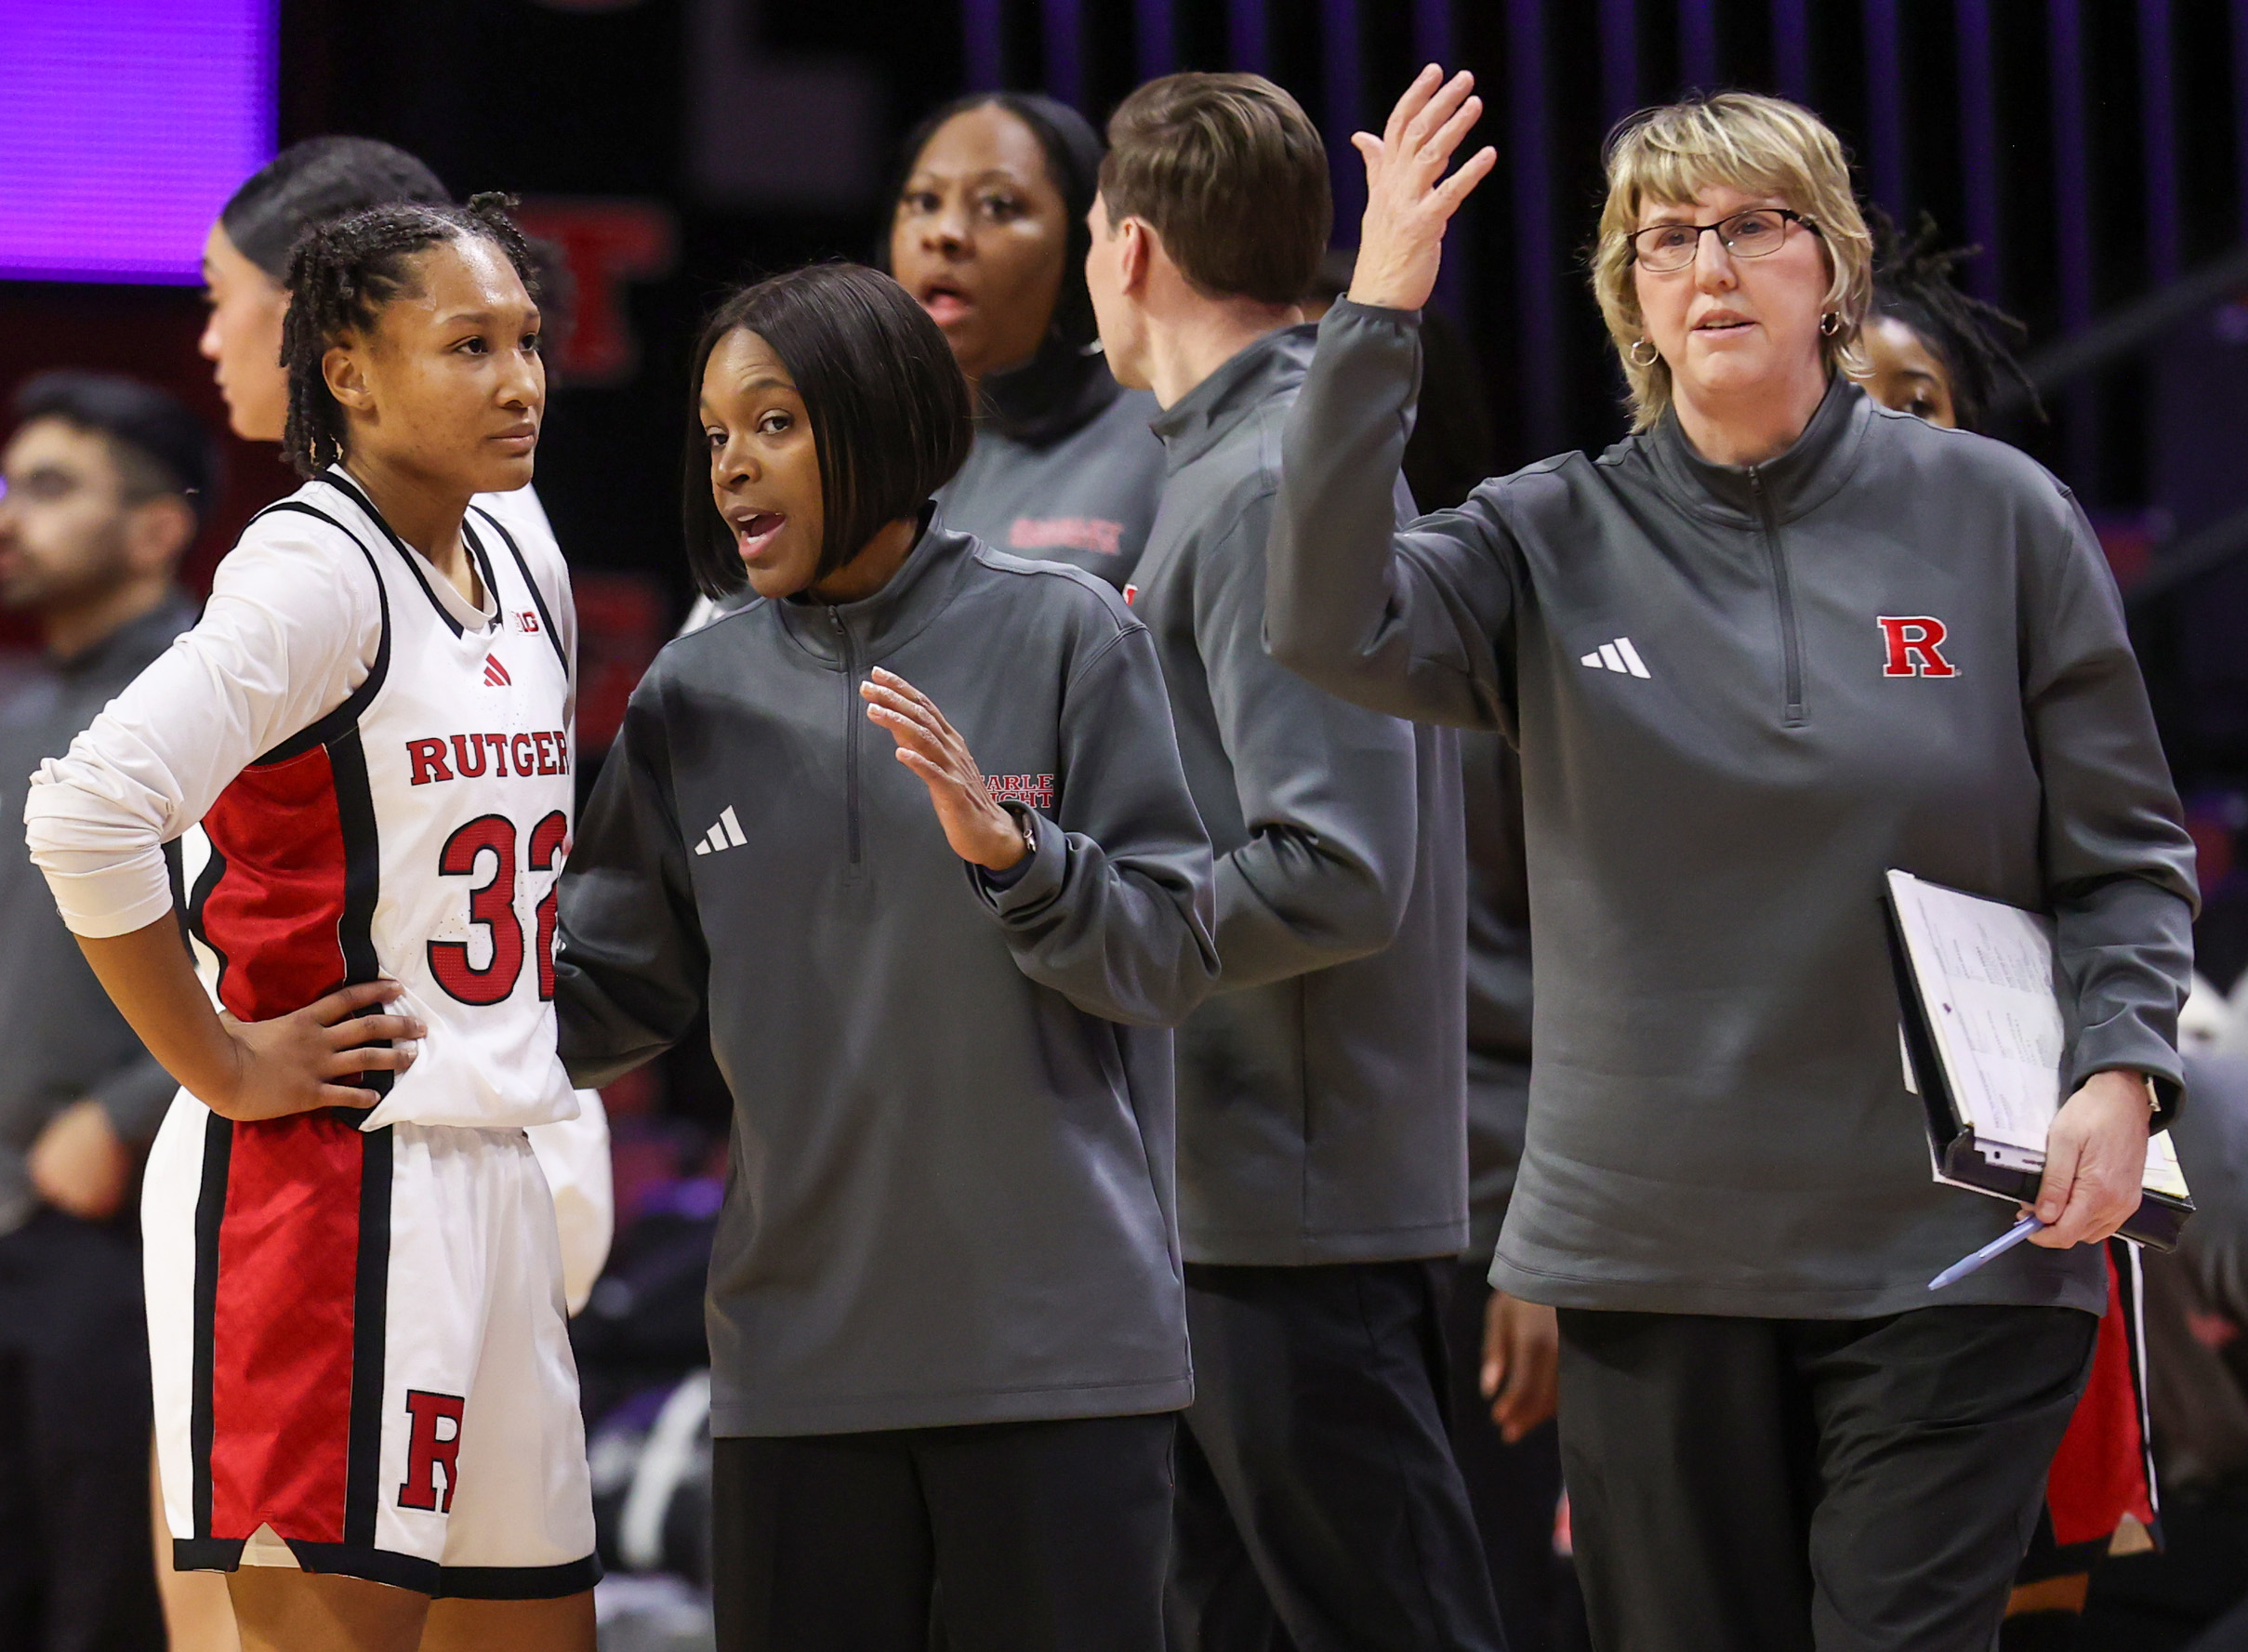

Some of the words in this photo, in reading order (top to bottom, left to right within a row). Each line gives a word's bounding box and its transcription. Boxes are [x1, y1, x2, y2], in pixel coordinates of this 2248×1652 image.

[1876, 615, 1955, 678] R
[979, 773, 1054, 792] ARLE
[427, 809, 574, 1007] 32
[397, 1389, 466, 1513] R
